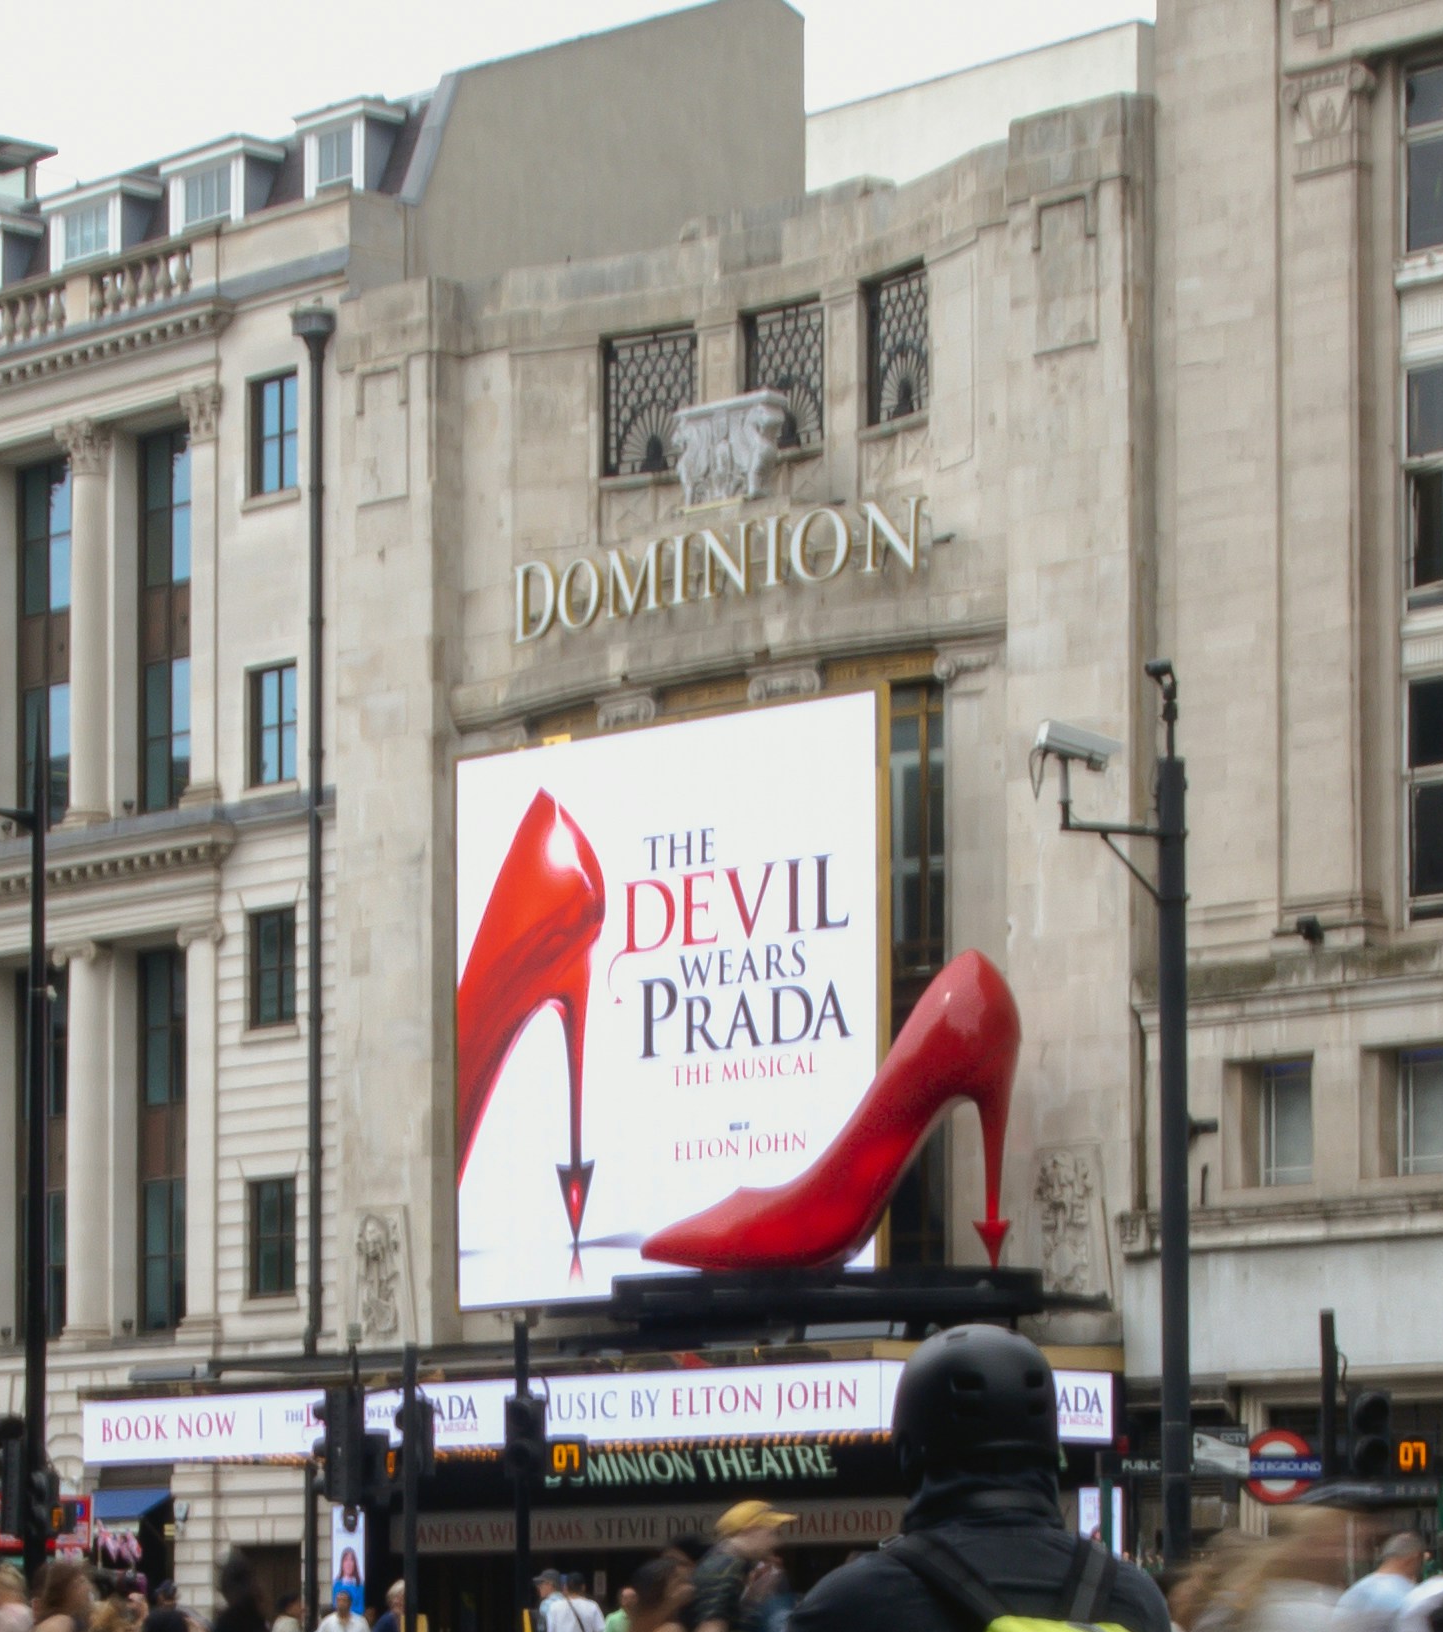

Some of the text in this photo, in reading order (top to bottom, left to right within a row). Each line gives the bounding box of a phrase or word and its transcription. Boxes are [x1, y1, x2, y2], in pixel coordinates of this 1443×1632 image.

[513, 495, 928, 643] DOMINION
[643, 827, 715, 871] THE
[622, 853, 850, 954] DEVIL
[678, 939, 807, 989] WEARS
[637, 977, 854, 1060] PRADA
[671, 1051, 818, 1087] THE MUSICAL
[674, 1130, 807, 1162] ELTON JOHN
[631, 1388, 660, 1419] BY
[672, 1383, 763, 1417] ELTON
[775, 1379, 858, 1420] JOHN
[101, 1410, 236, 1443] BOOK NOW
[552, 1443, 579, 1473] 07
[696, 1443, 838, 1483] THEATRE
[1399, 1441, 1427, 1472] 07
[415, 1522, 484, 1545] ANESSA
[594, 1515, 659, 1540] STEVIE
